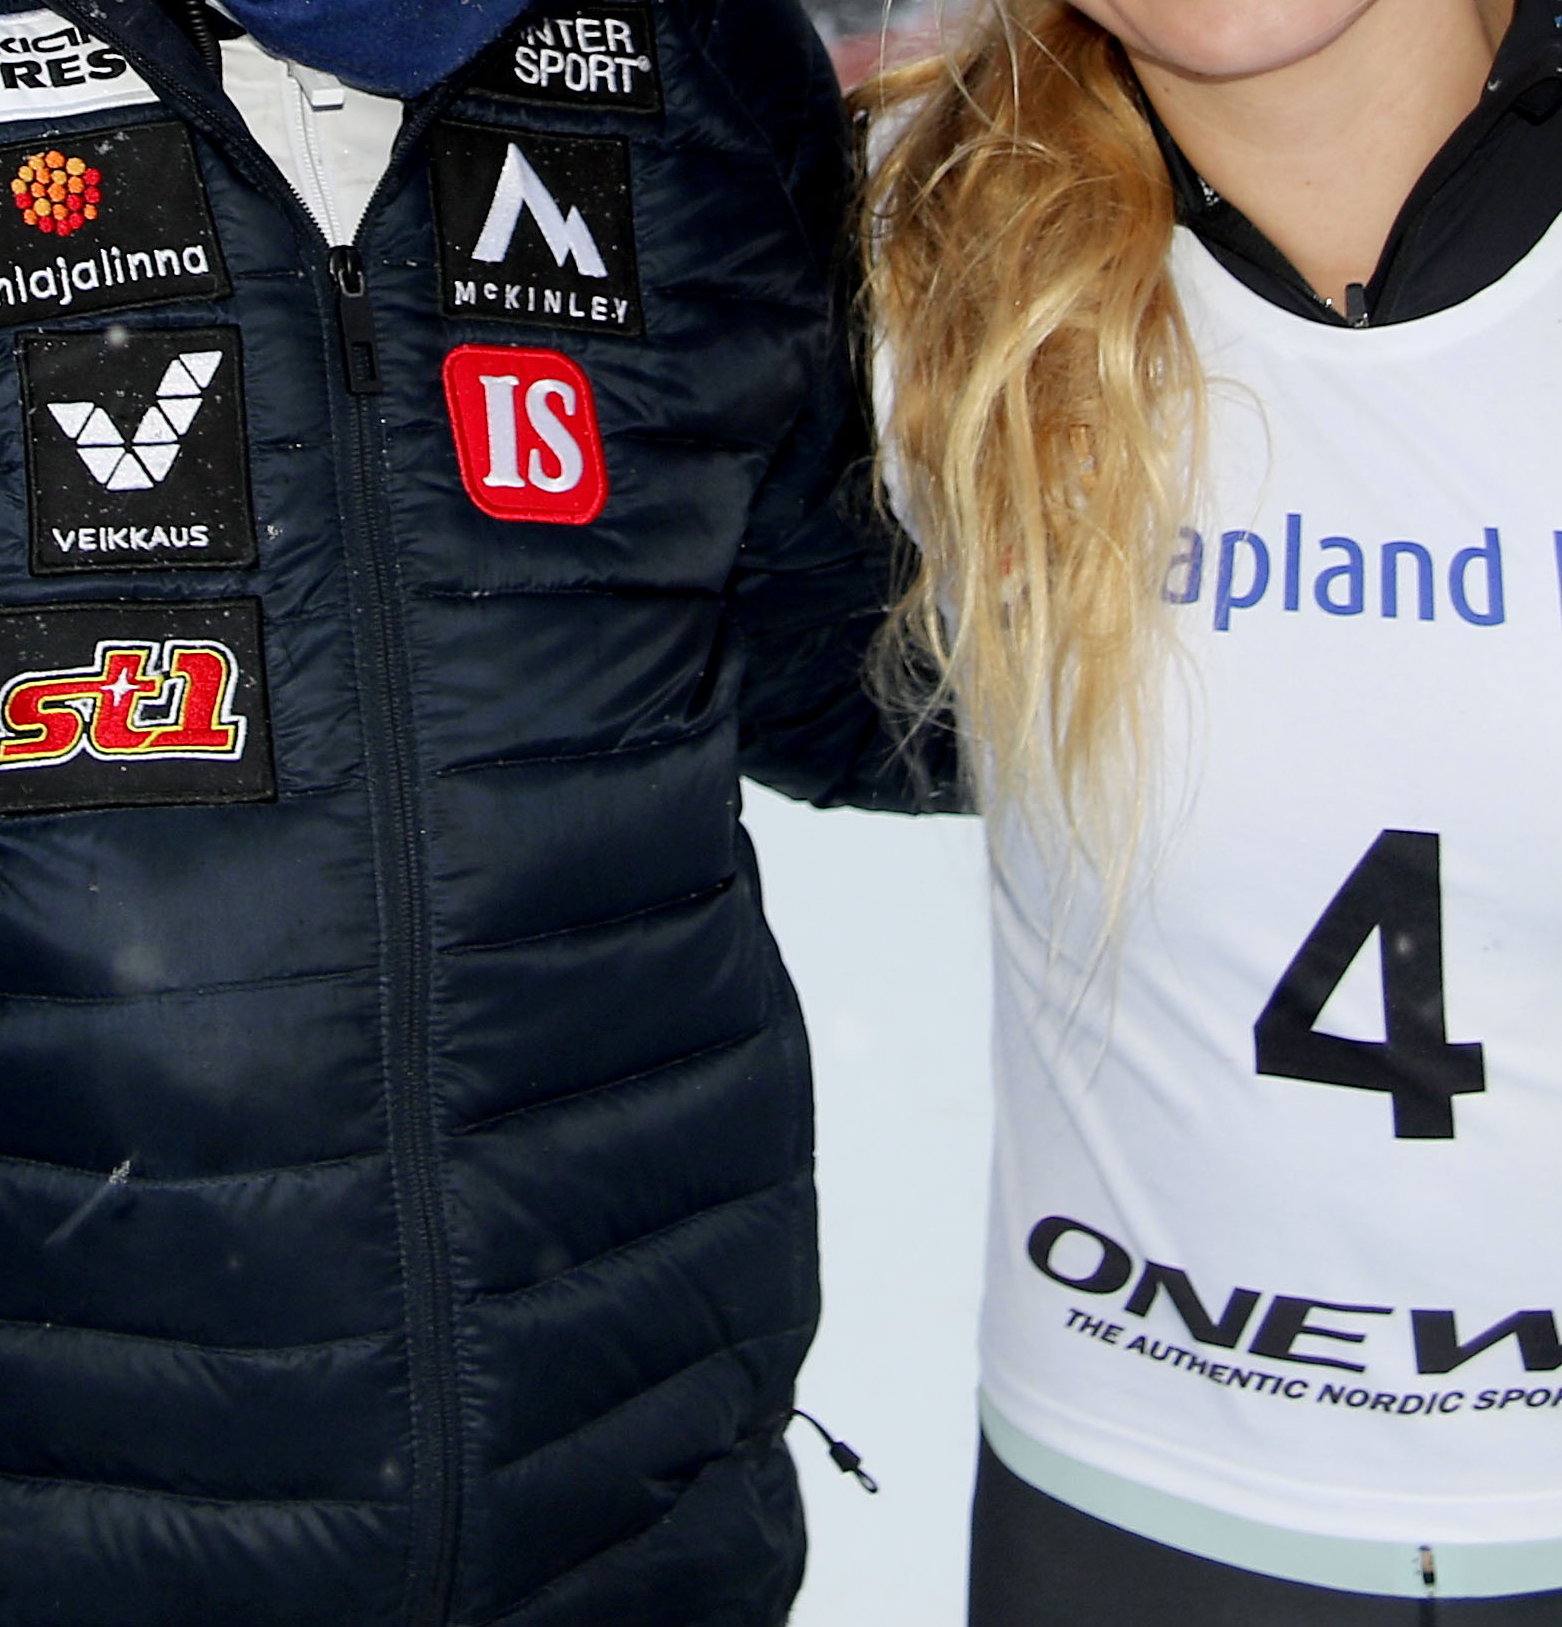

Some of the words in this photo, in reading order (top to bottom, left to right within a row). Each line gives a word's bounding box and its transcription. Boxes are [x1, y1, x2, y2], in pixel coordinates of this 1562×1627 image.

[521, 17, 635, 53] NTER
[478, 374, 584, 494] IS
[51, 525, 210, 553] VEIKKAUS
[1161, 513, 1506, 632] apland
[1253, 829, 1486, 1140] 4
[1066, 1308, 1122, 1346] THE
[1127, 1334, 1310, 1401] AUTHENTIC
[1318, 1383, 1464, 1415] NORDIC
